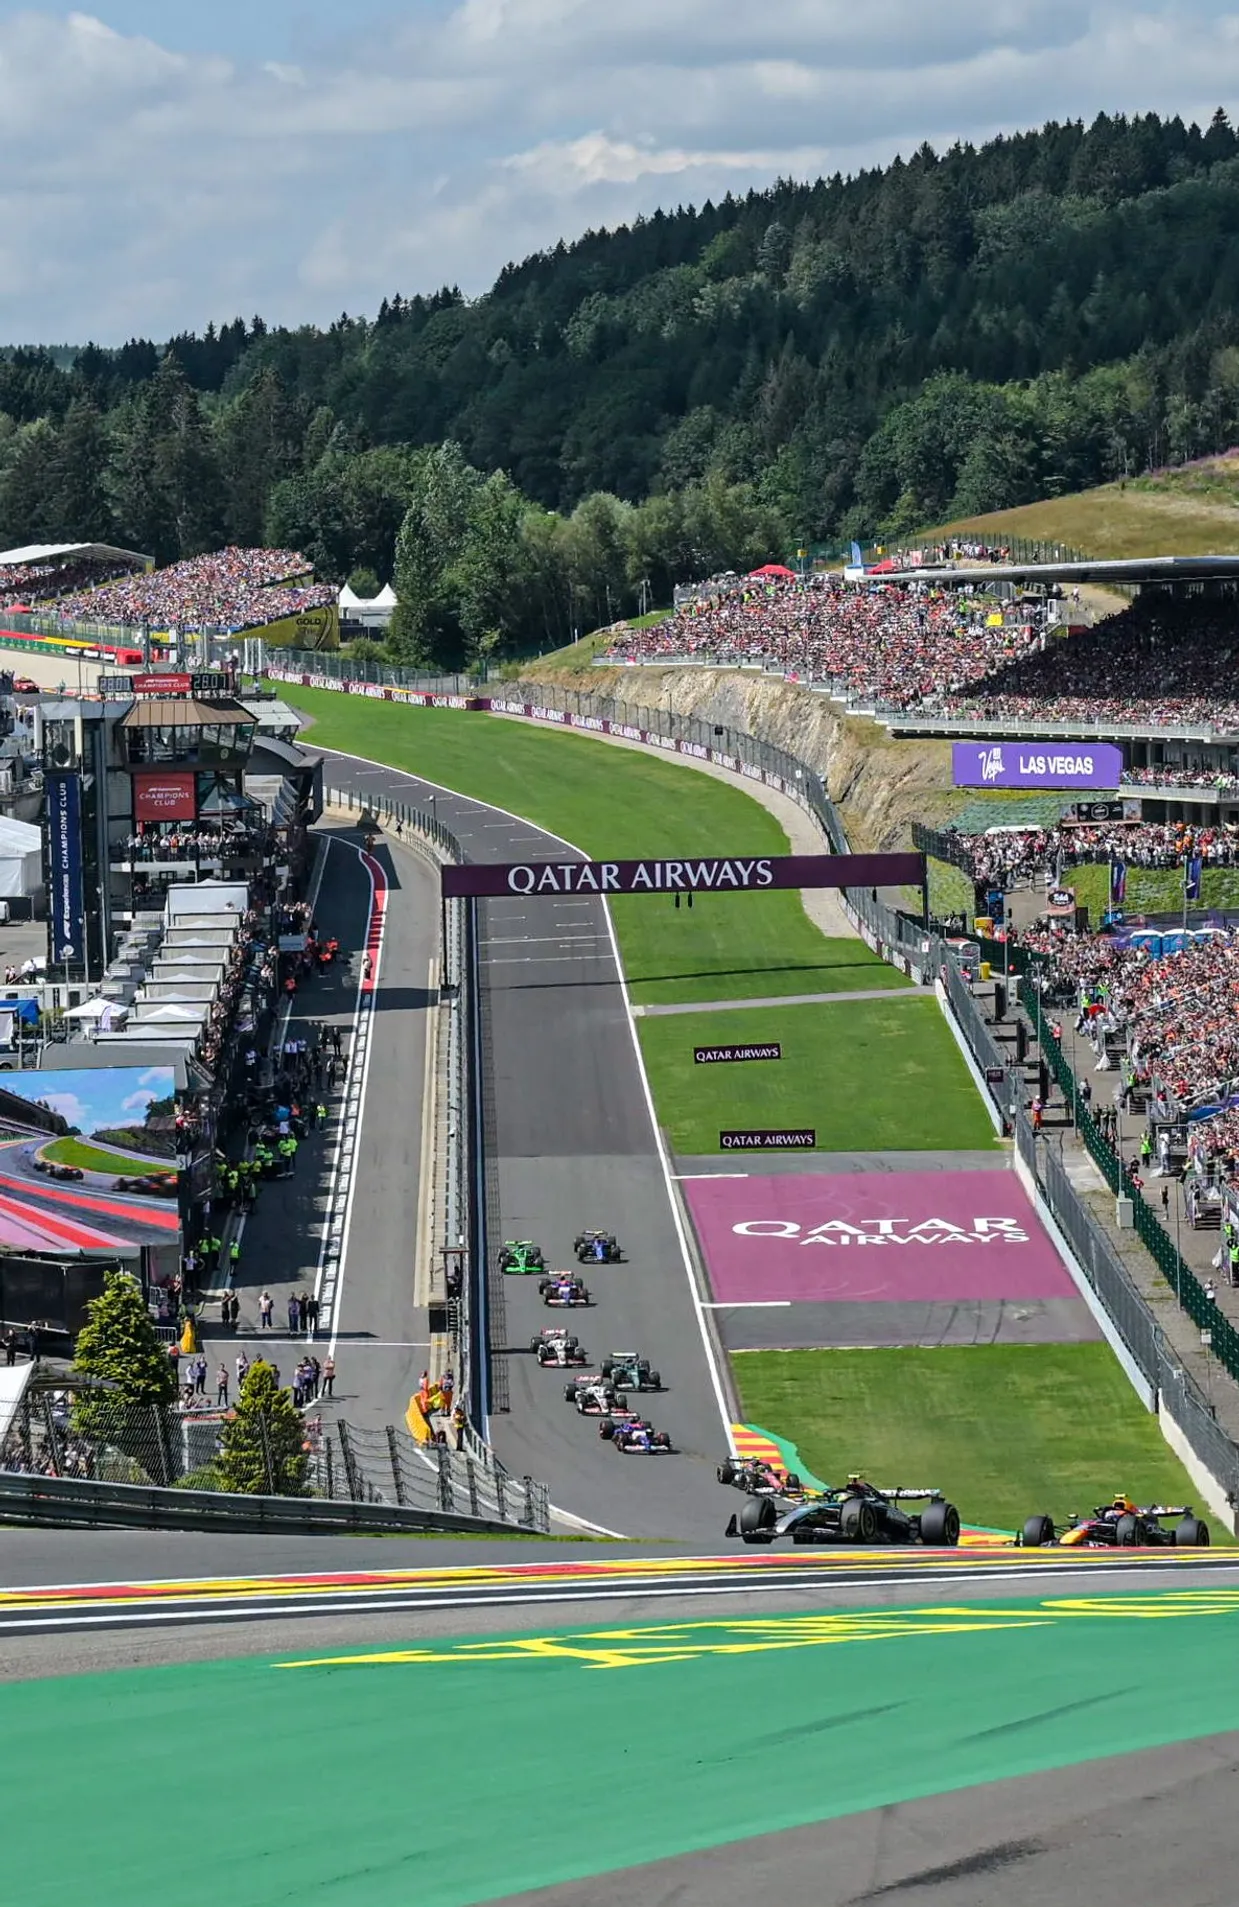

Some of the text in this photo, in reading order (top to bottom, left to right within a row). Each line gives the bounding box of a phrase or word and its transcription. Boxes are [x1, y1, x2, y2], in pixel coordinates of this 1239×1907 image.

[1019, 755, 1094, 775] LAS VEGAS
[59, 782, 67, 808] CLUB
[139, 791, 190, 800] CHAMPIONS
[154, 799, 176, 807] CLUB
[60, 810, 69, 869] CHAMPIONS
[507, 860, 773, 894] QATAR AIRWAYS
[696, 1047, 779, 1062] QATAR AIRWAYS
[722, 1135, 813, 1147] QATAR AIRWAYS
[732, 1217, 1025, 1238] QATAR
[799, 1231, 1030, 1246] AIRWAYS
